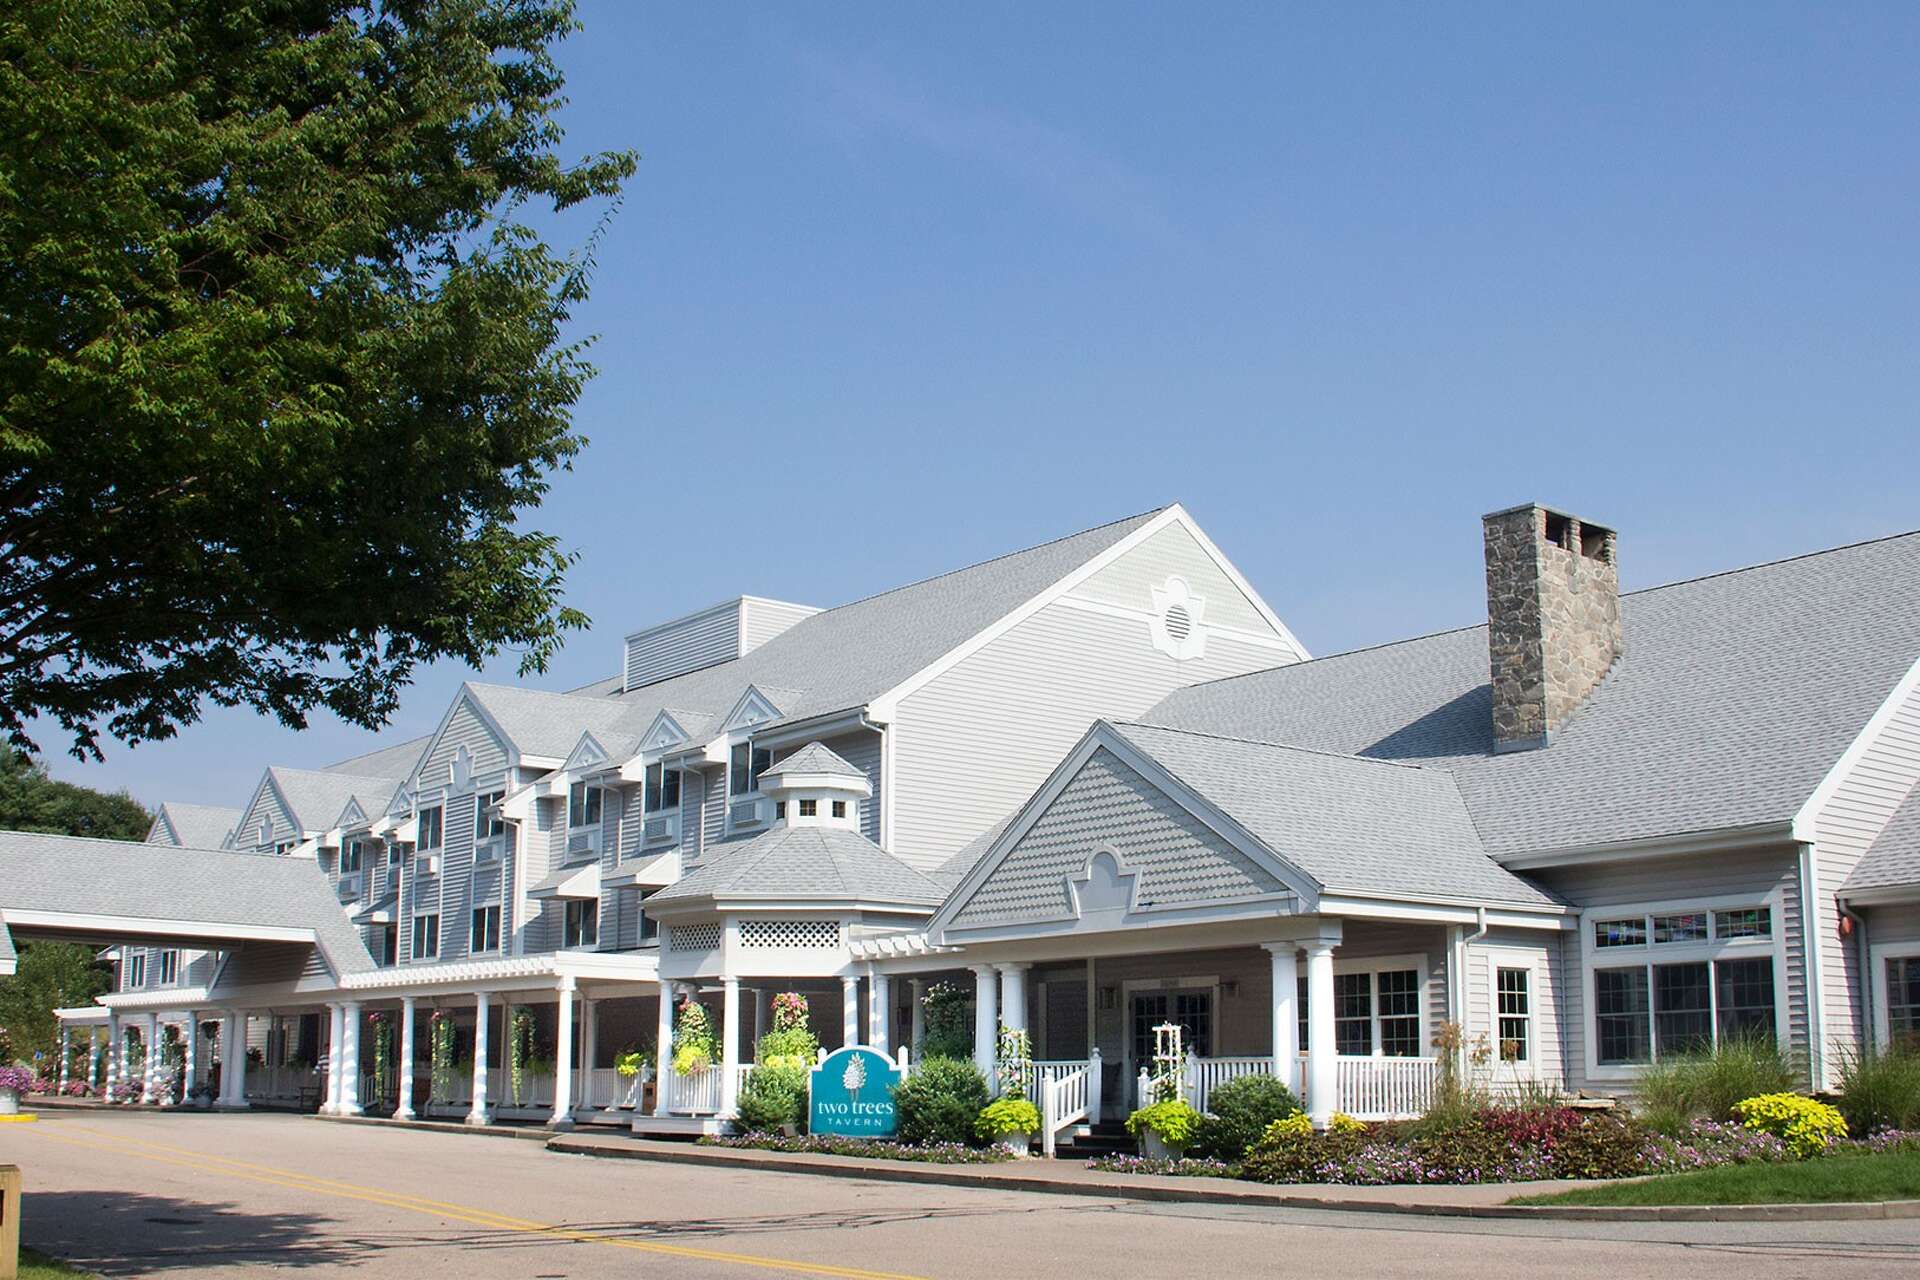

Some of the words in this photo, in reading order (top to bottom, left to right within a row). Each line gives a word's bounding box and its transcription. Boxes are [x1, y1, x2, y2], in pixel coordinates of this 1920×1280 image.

[818, 1102, 848, 1114] two
[852, 1102, 894, 1115] trees
[828, 1118, 882, 1127] TAVERN
